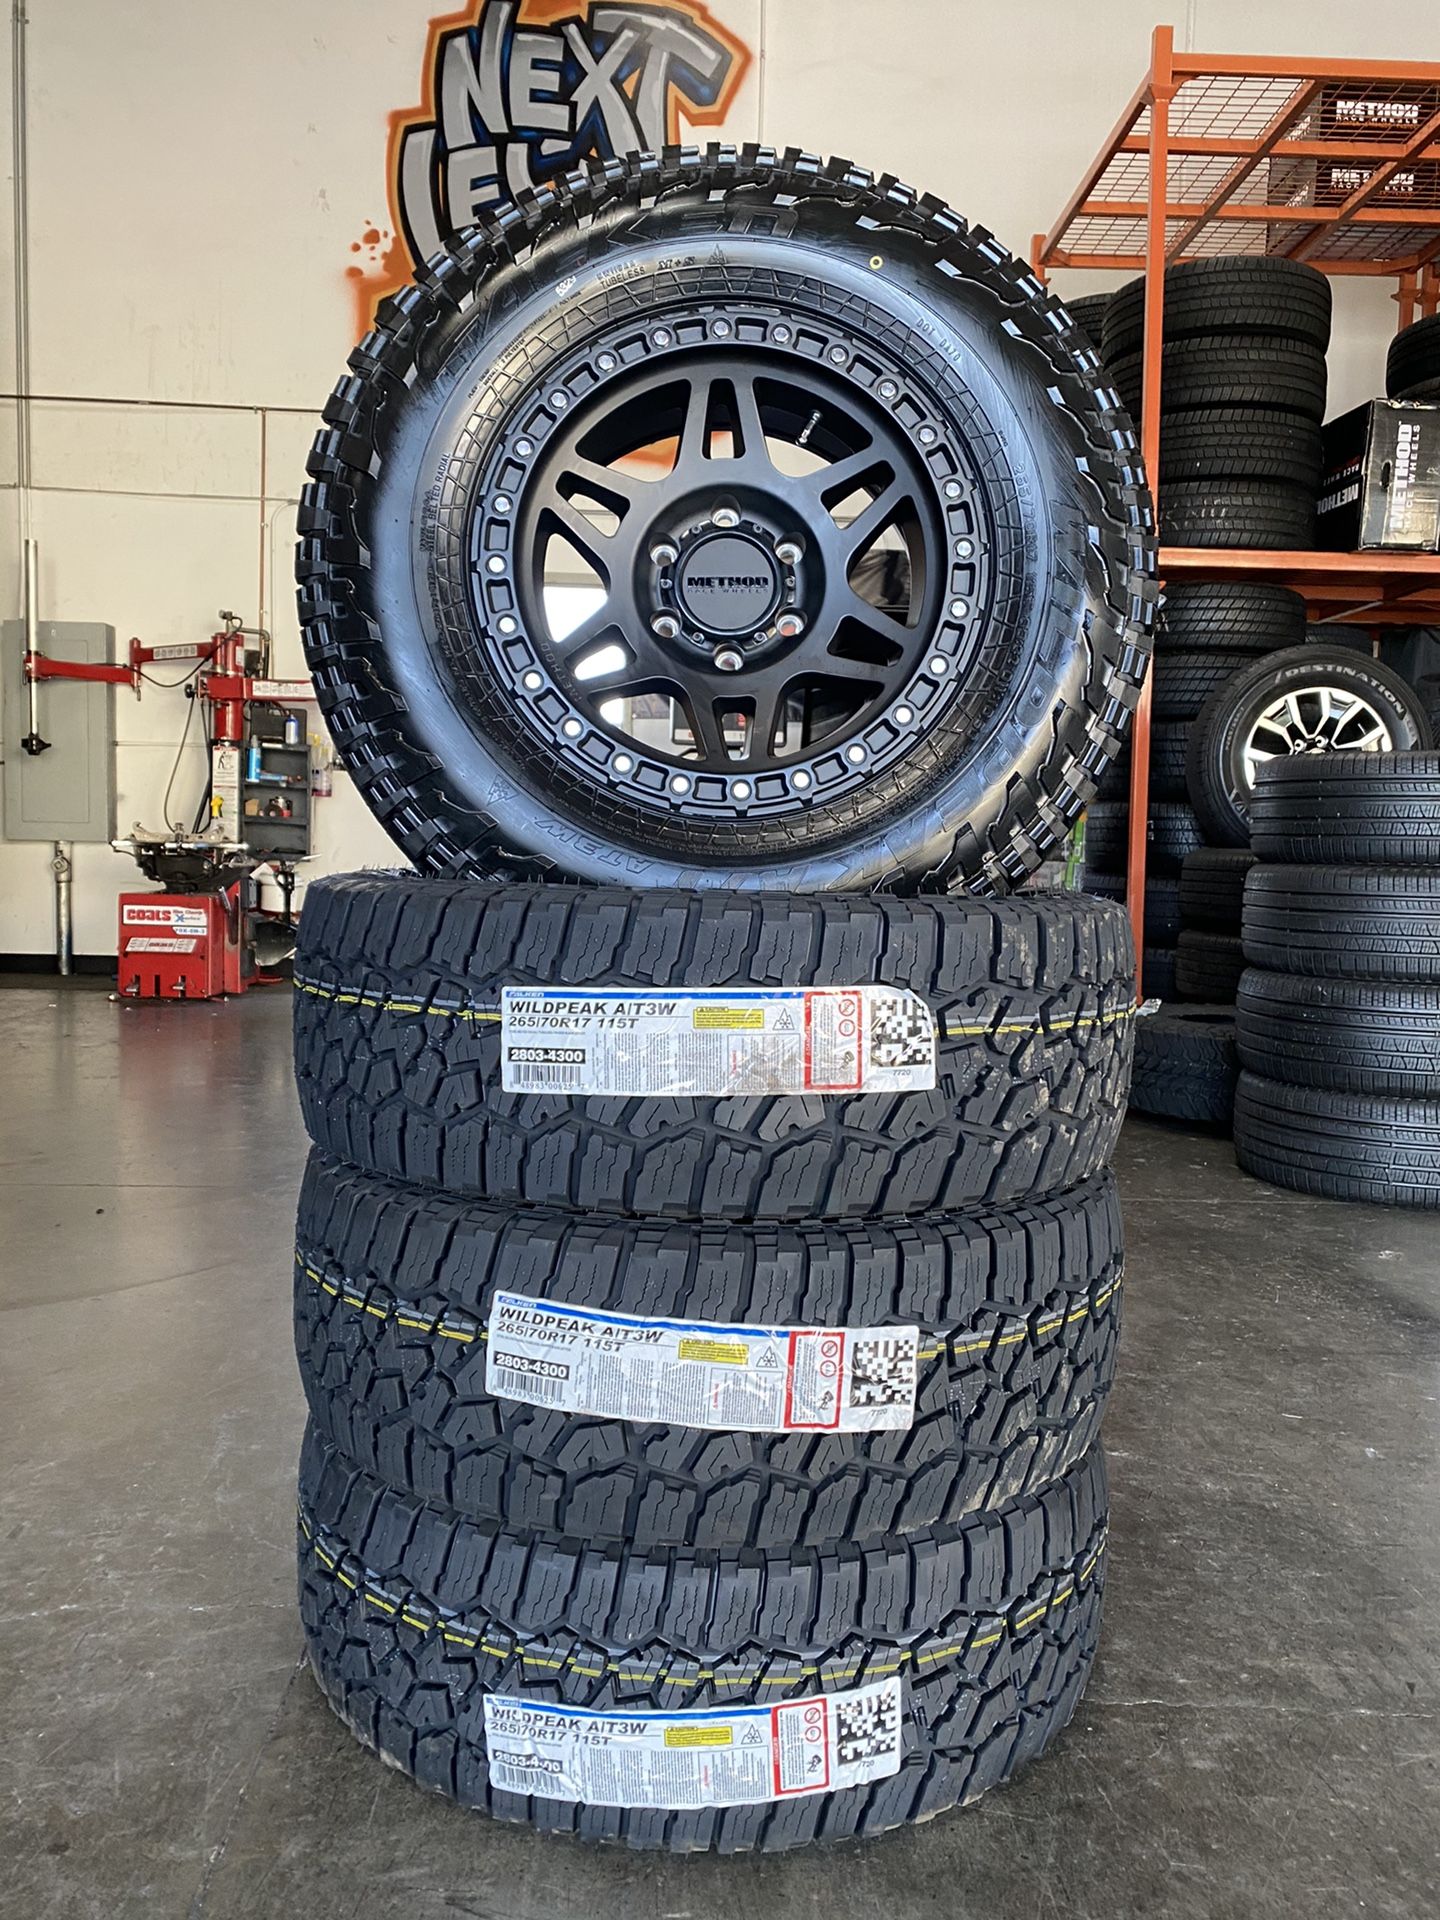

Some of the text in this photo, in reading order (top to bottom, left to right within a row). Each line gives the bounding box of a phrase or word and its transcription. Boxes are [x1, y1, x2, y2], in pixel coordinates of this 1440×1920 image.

[440, 0, 727, 158] NEXT
[1336, 100, 1419, 117] METHOD
[600, 266, 646, 289] TUBELESS
[1408, 425, 1420, 483] WHEELS
[433, 451, 451, 482] RADIAL
[1390, 424, 1412, 528] METHOD
[688, 577, 768, 587] METHOD
[1285, 664, 1405, 714] DESTINATION
[510, 1001, 608, 1015] WILDPEAK
[598, 1018, 639, 1029] 115T
[510, 1049, 583, 1062] 2803-4300
[500, 1306, 594, 1335] WILDPEAK
[583, 1338, 626, 1352] 115T
[496, 1353, 567, 1378] 2803-4300
[492, 1706, 582, 1732] WILDPEAK
[573, 1734, 613, 1746] 115T
